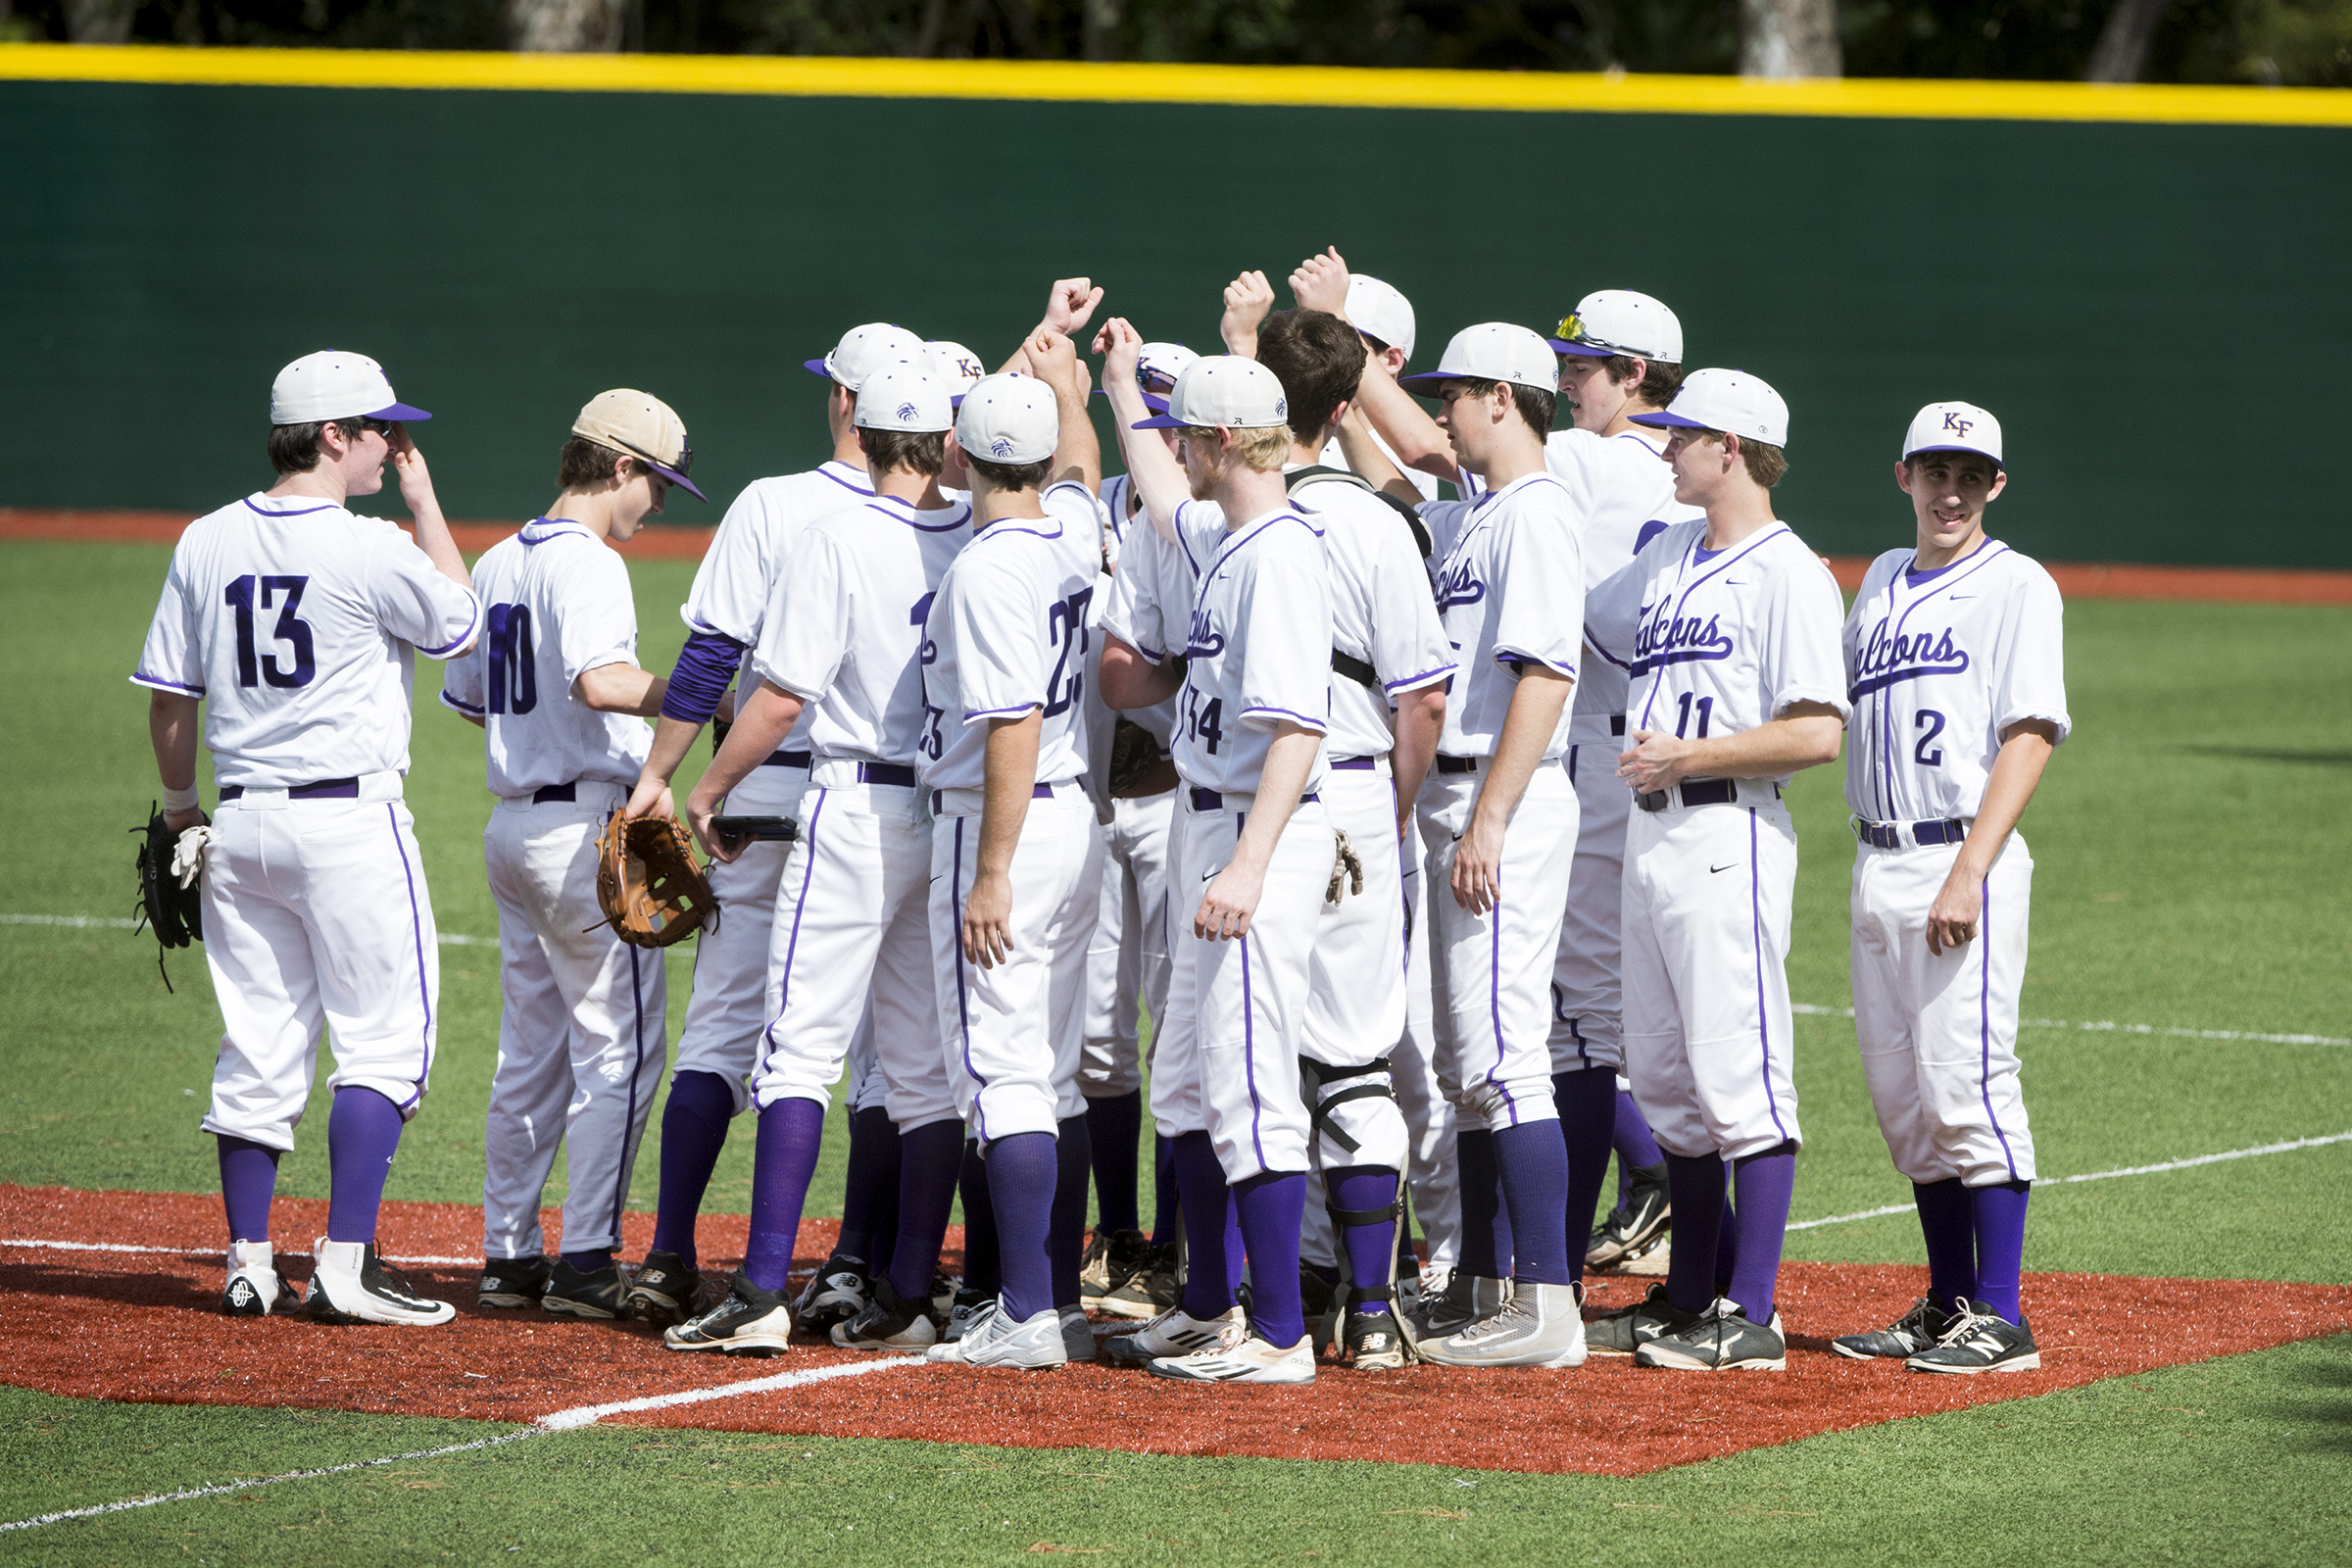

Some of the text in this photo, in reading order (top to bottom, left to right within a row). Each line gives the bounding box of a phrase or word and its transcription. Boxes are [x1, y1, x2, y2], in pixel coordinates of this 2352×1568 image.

[1942, 413, 1974, 438] KF
[224, 574, 316, 688] 13
[488, 603, 537, 714] 10
[1851, 616, 1963, 691] alcons
[1187, 684, 1222, 756] 34
[1915, 709, 1946, 767] 2
